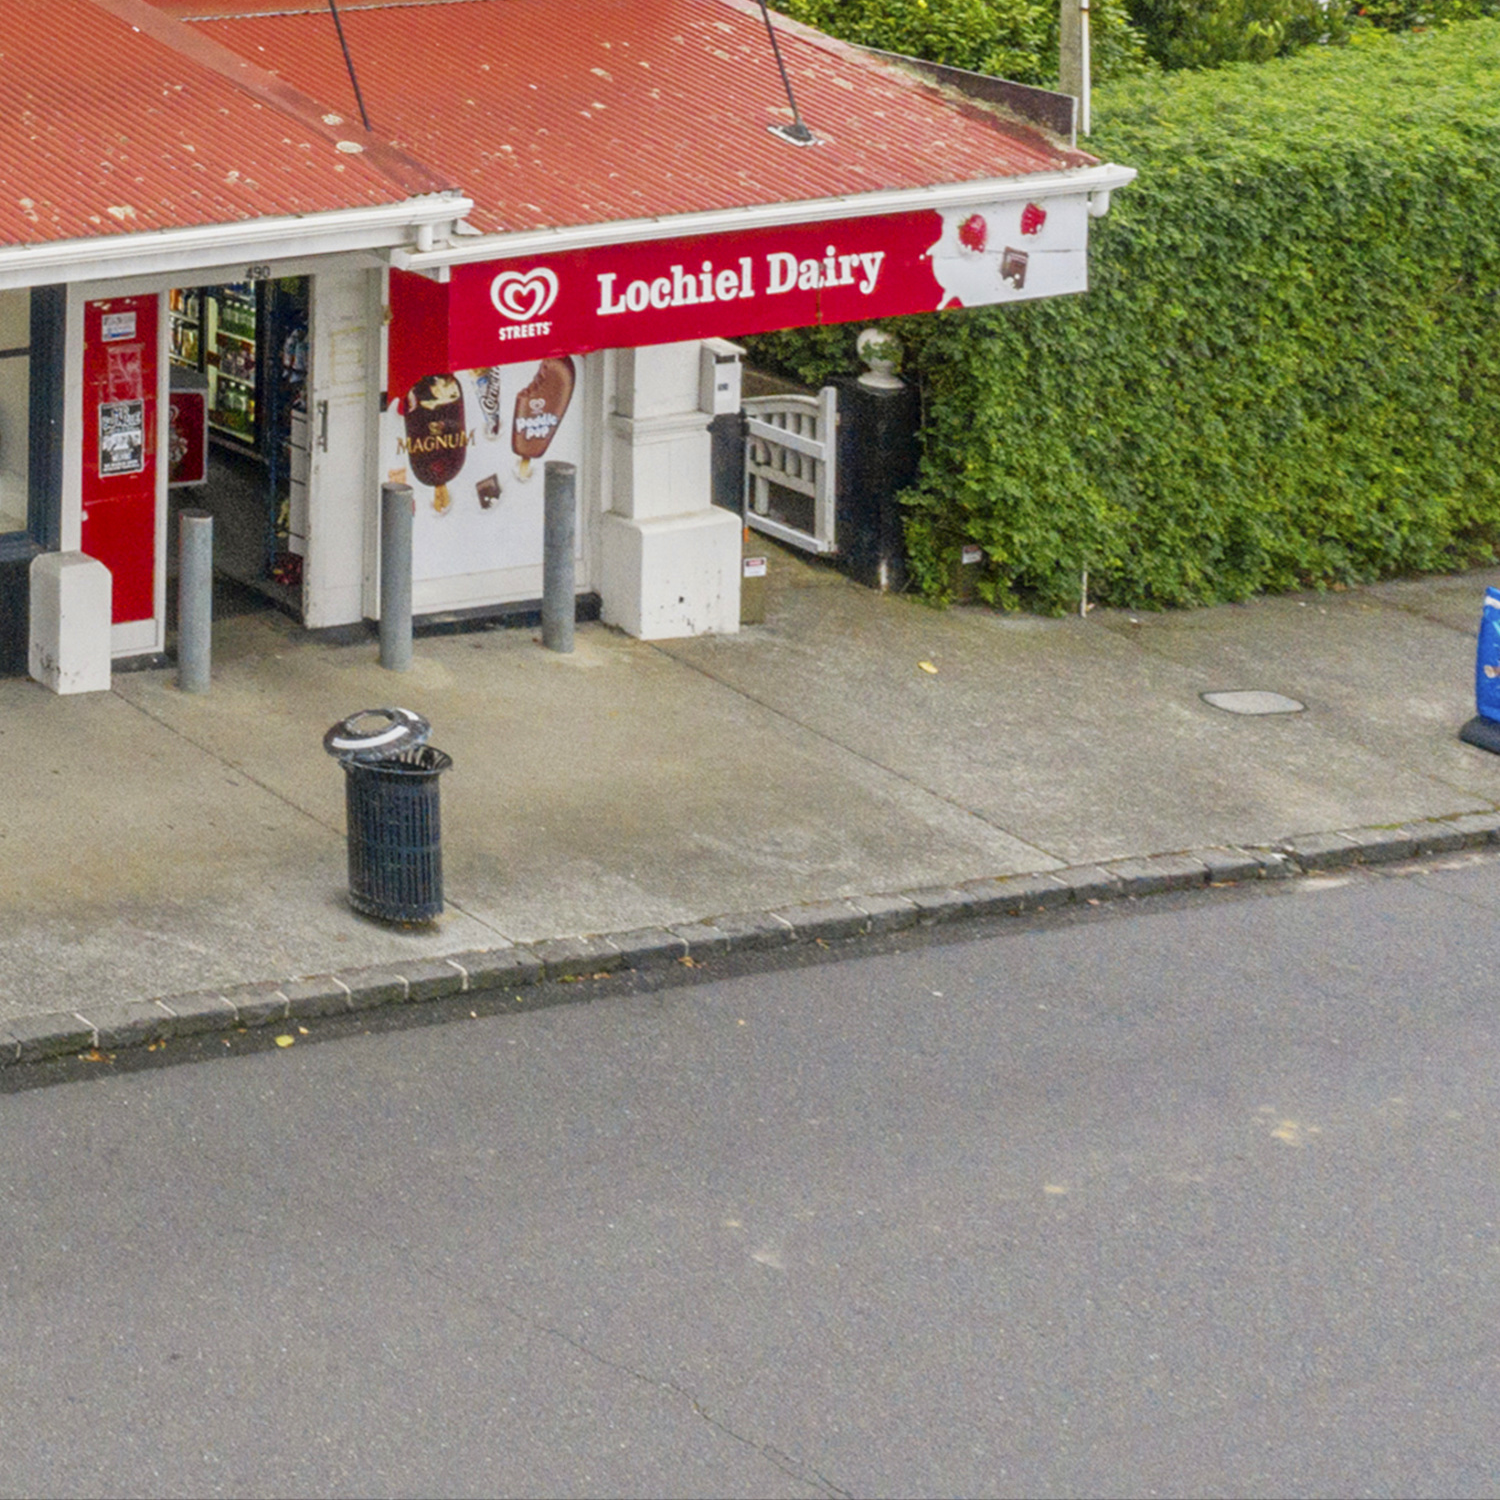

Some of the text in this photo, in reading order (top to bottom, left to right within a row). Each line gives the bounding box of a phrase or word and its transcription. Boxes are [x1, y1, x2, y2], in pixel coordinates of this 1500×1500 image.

[245, 265, 271, 280] 490
[596, 245, 886, 315] Lochiel Dairy
[498, 321, 551, 341] STREETS
[395, 427, 476, 456] MAGNUM
